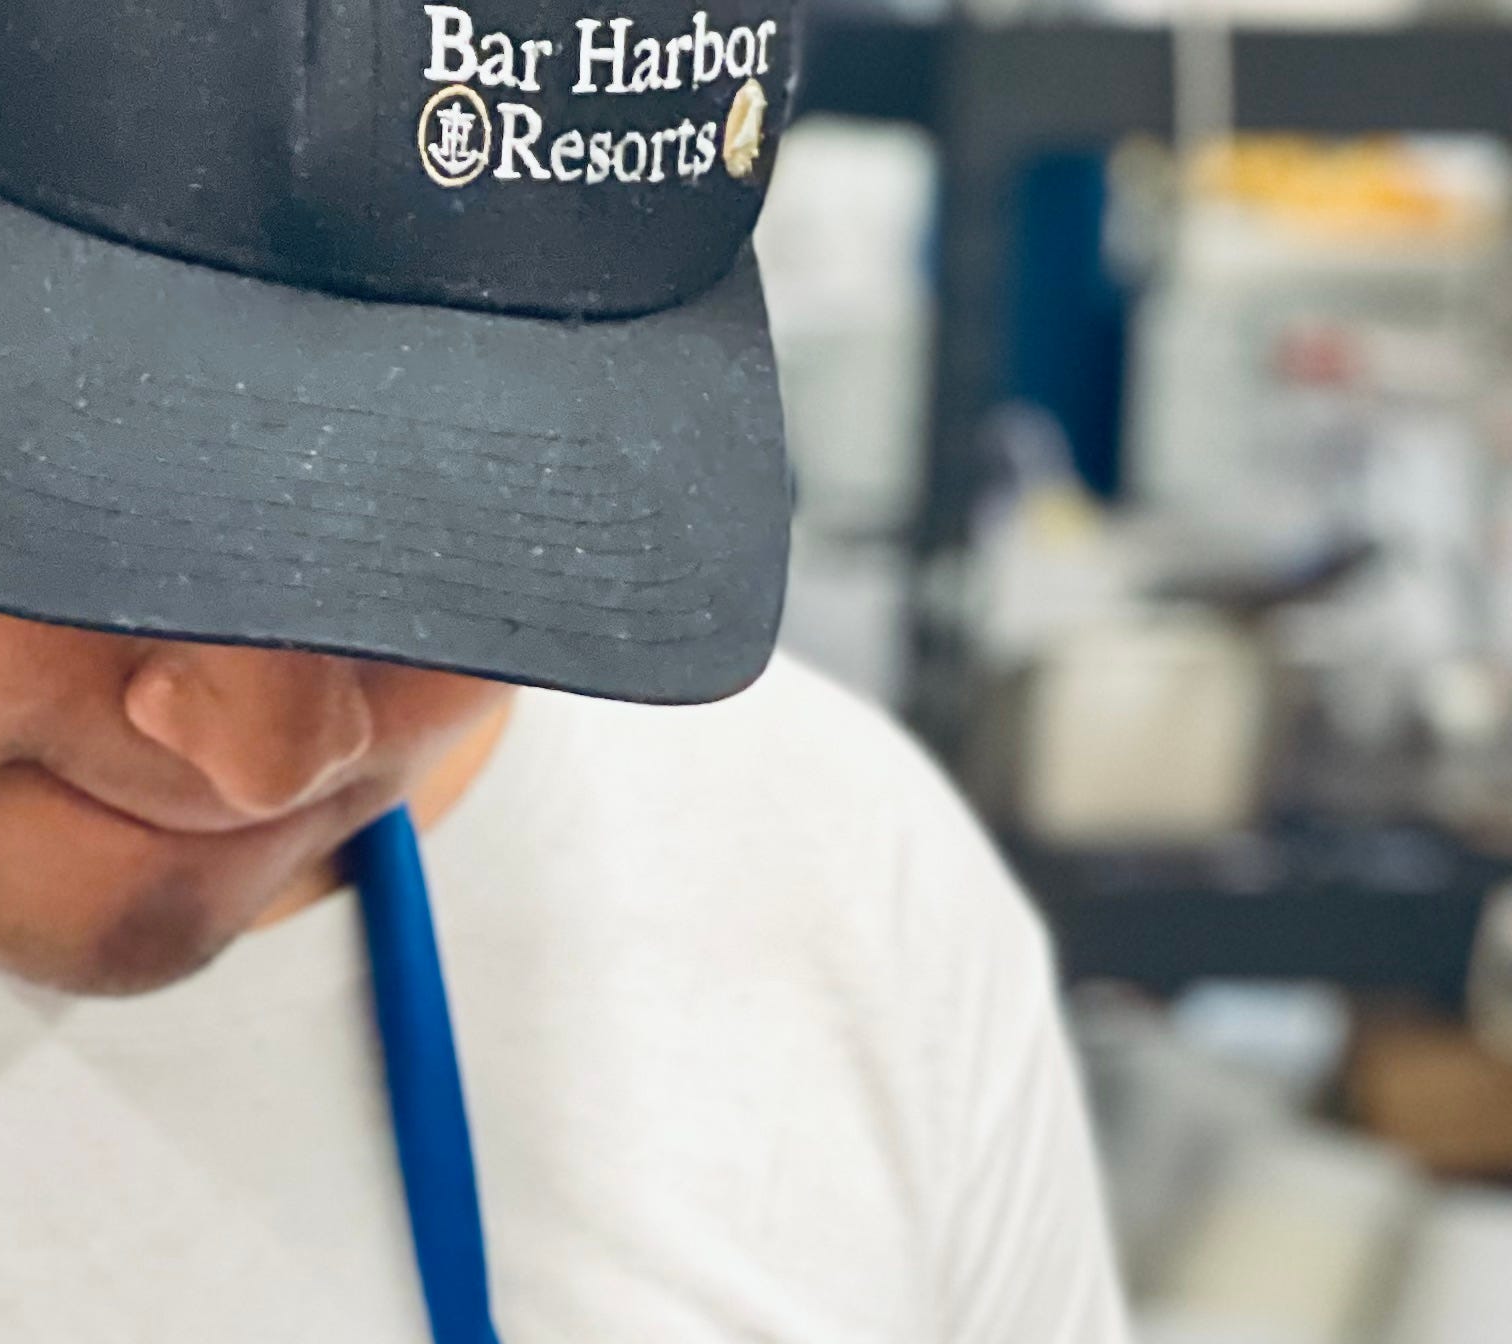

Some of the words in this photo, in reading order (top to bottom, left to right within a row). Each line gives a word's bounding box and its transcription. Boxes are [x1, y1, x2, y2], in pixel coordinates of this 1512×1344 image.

[423, 4, 553, 92] Bar
[571, 11, 777, 94] Harbor
[492, 101, 718, 183] Resorts
